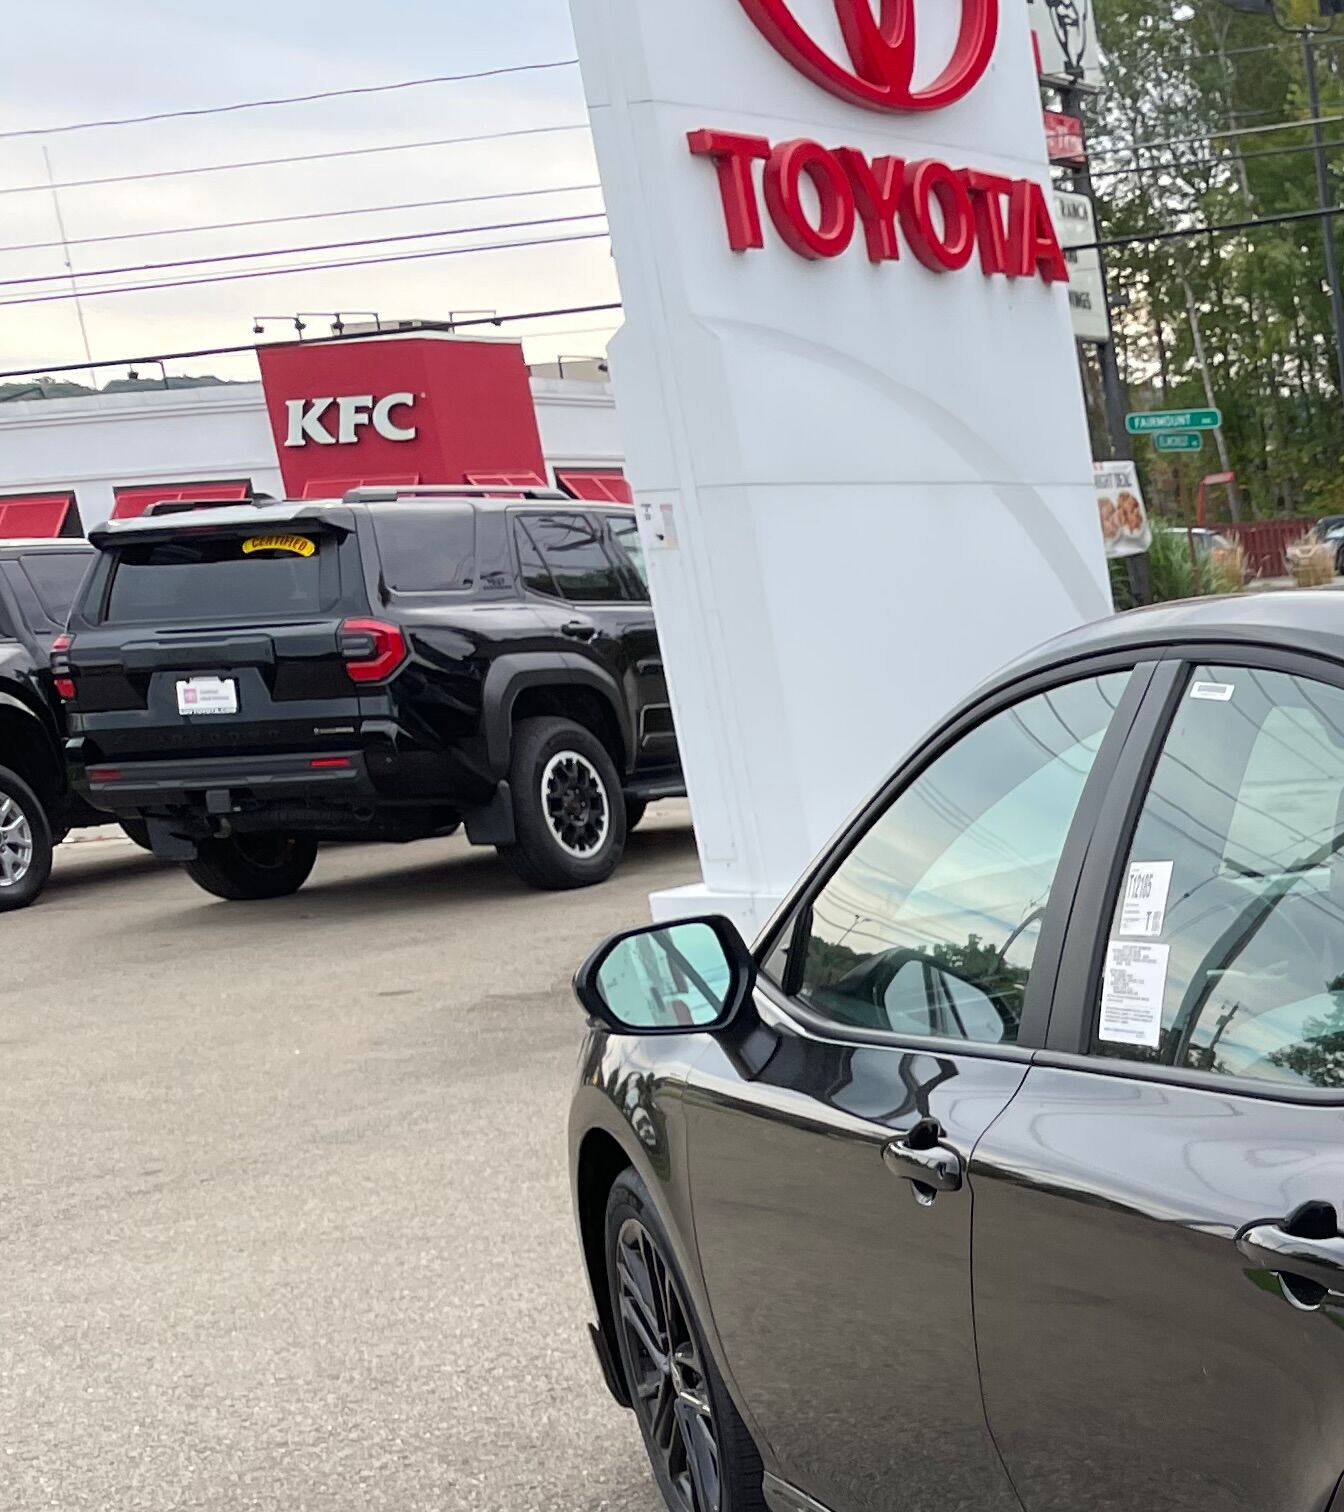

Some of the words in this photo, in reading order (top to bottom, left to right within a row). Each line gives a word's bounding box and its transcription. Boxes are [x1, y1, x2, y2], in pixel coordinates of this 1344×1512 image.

[686, 127, 1070, 282] TOYOTA
[284, 391, 416, 447] KFC
[251, 534, 309, 552] CERTIFIED
